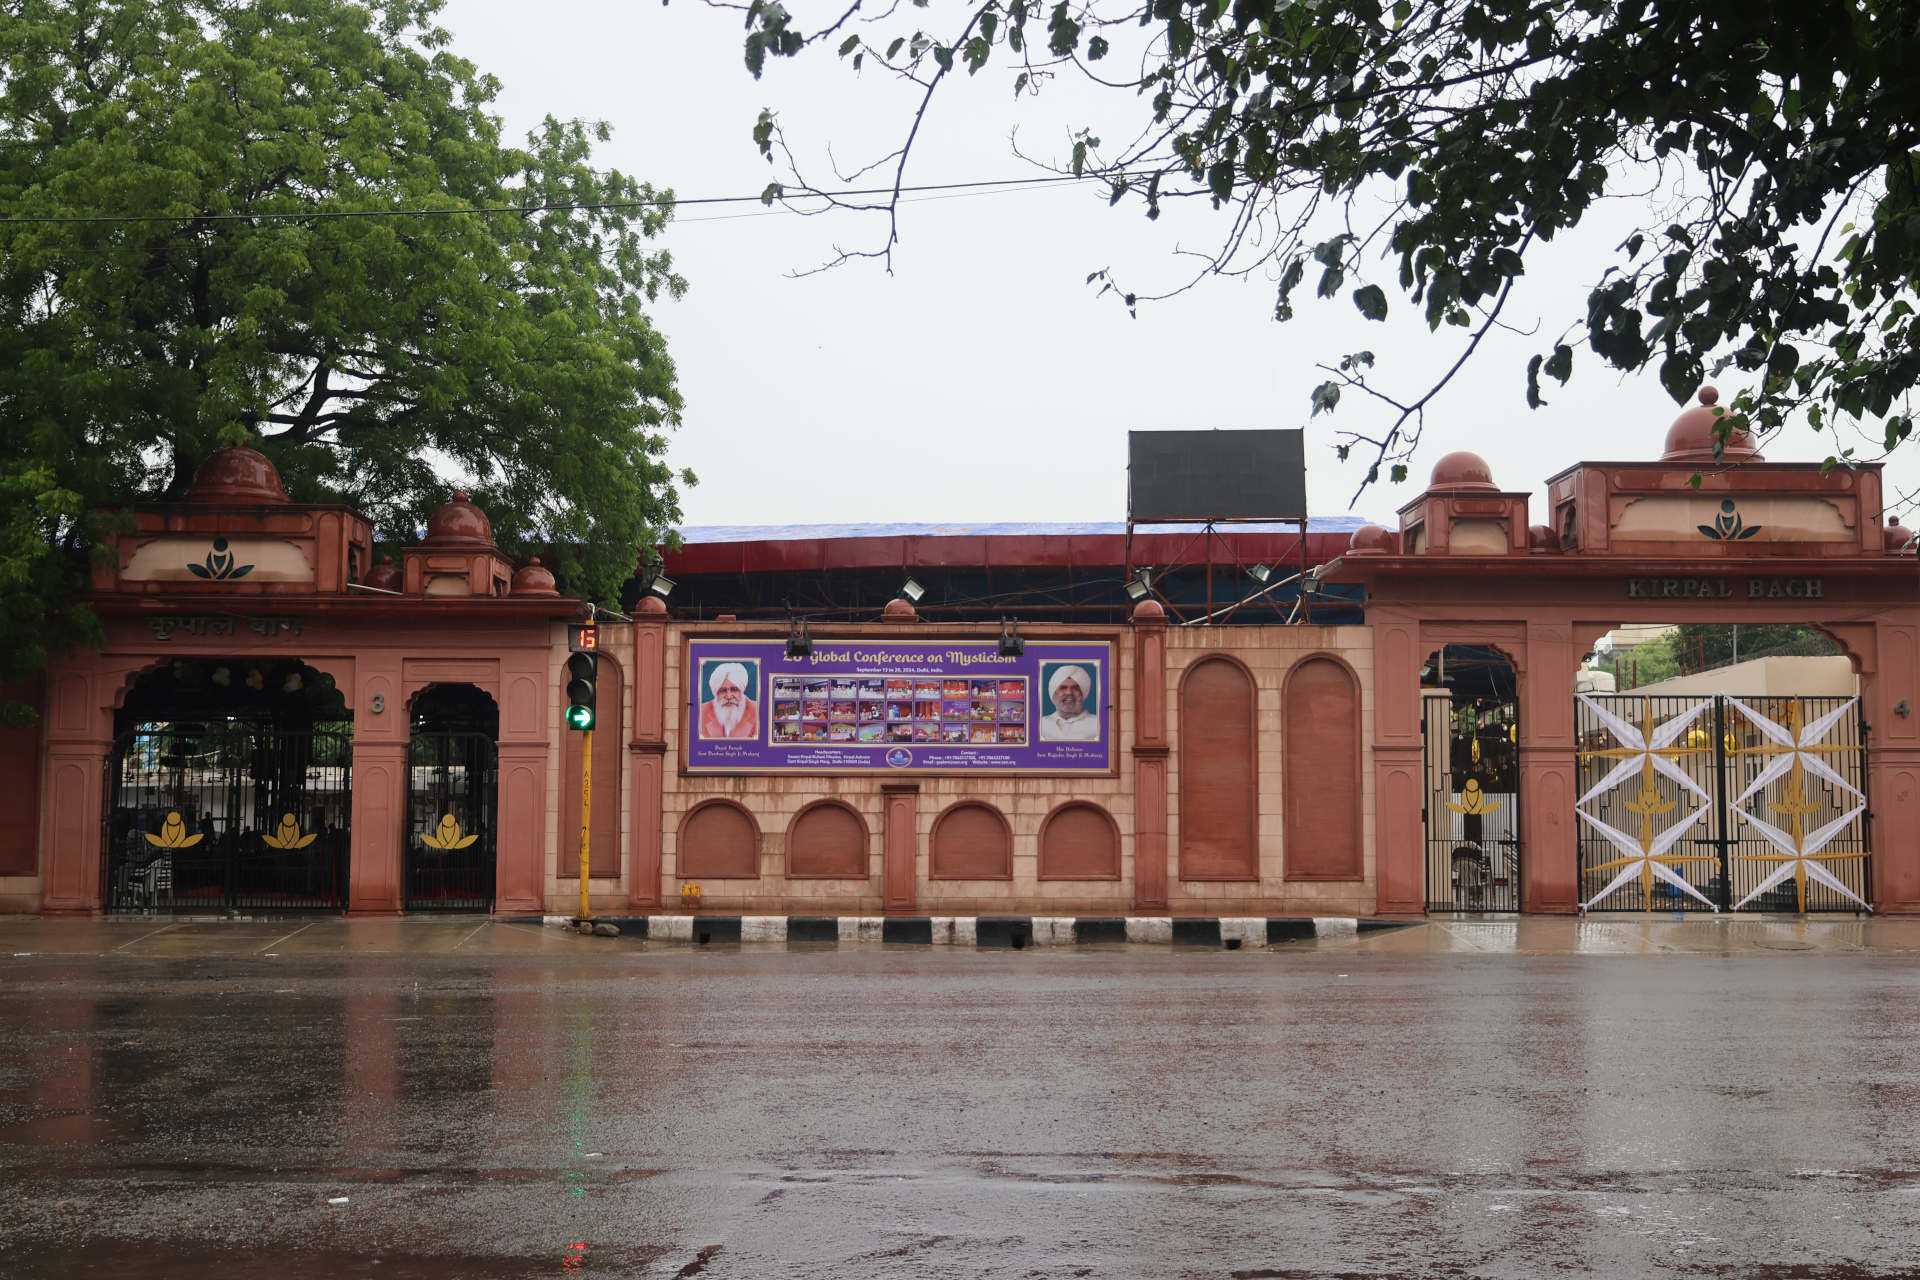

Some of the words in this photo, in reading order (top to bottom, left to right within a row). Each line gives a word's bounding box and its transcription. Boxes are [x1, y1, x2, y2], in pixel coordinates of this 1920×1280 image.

[1629, 580, 1733, 597] KIRPAL
[1749, 580, 1823, 597] BAGH
[580, 629, 596, 648] 15
[809, 650, 850, 664] Global
[854, 650, 924, 665] Conference
[927, 653, 943, 663] on
[946, 650, 1017, 666] Mysticism
[371, 693, 385, 714] 3
[1893, 699, 1911, 719] 4
